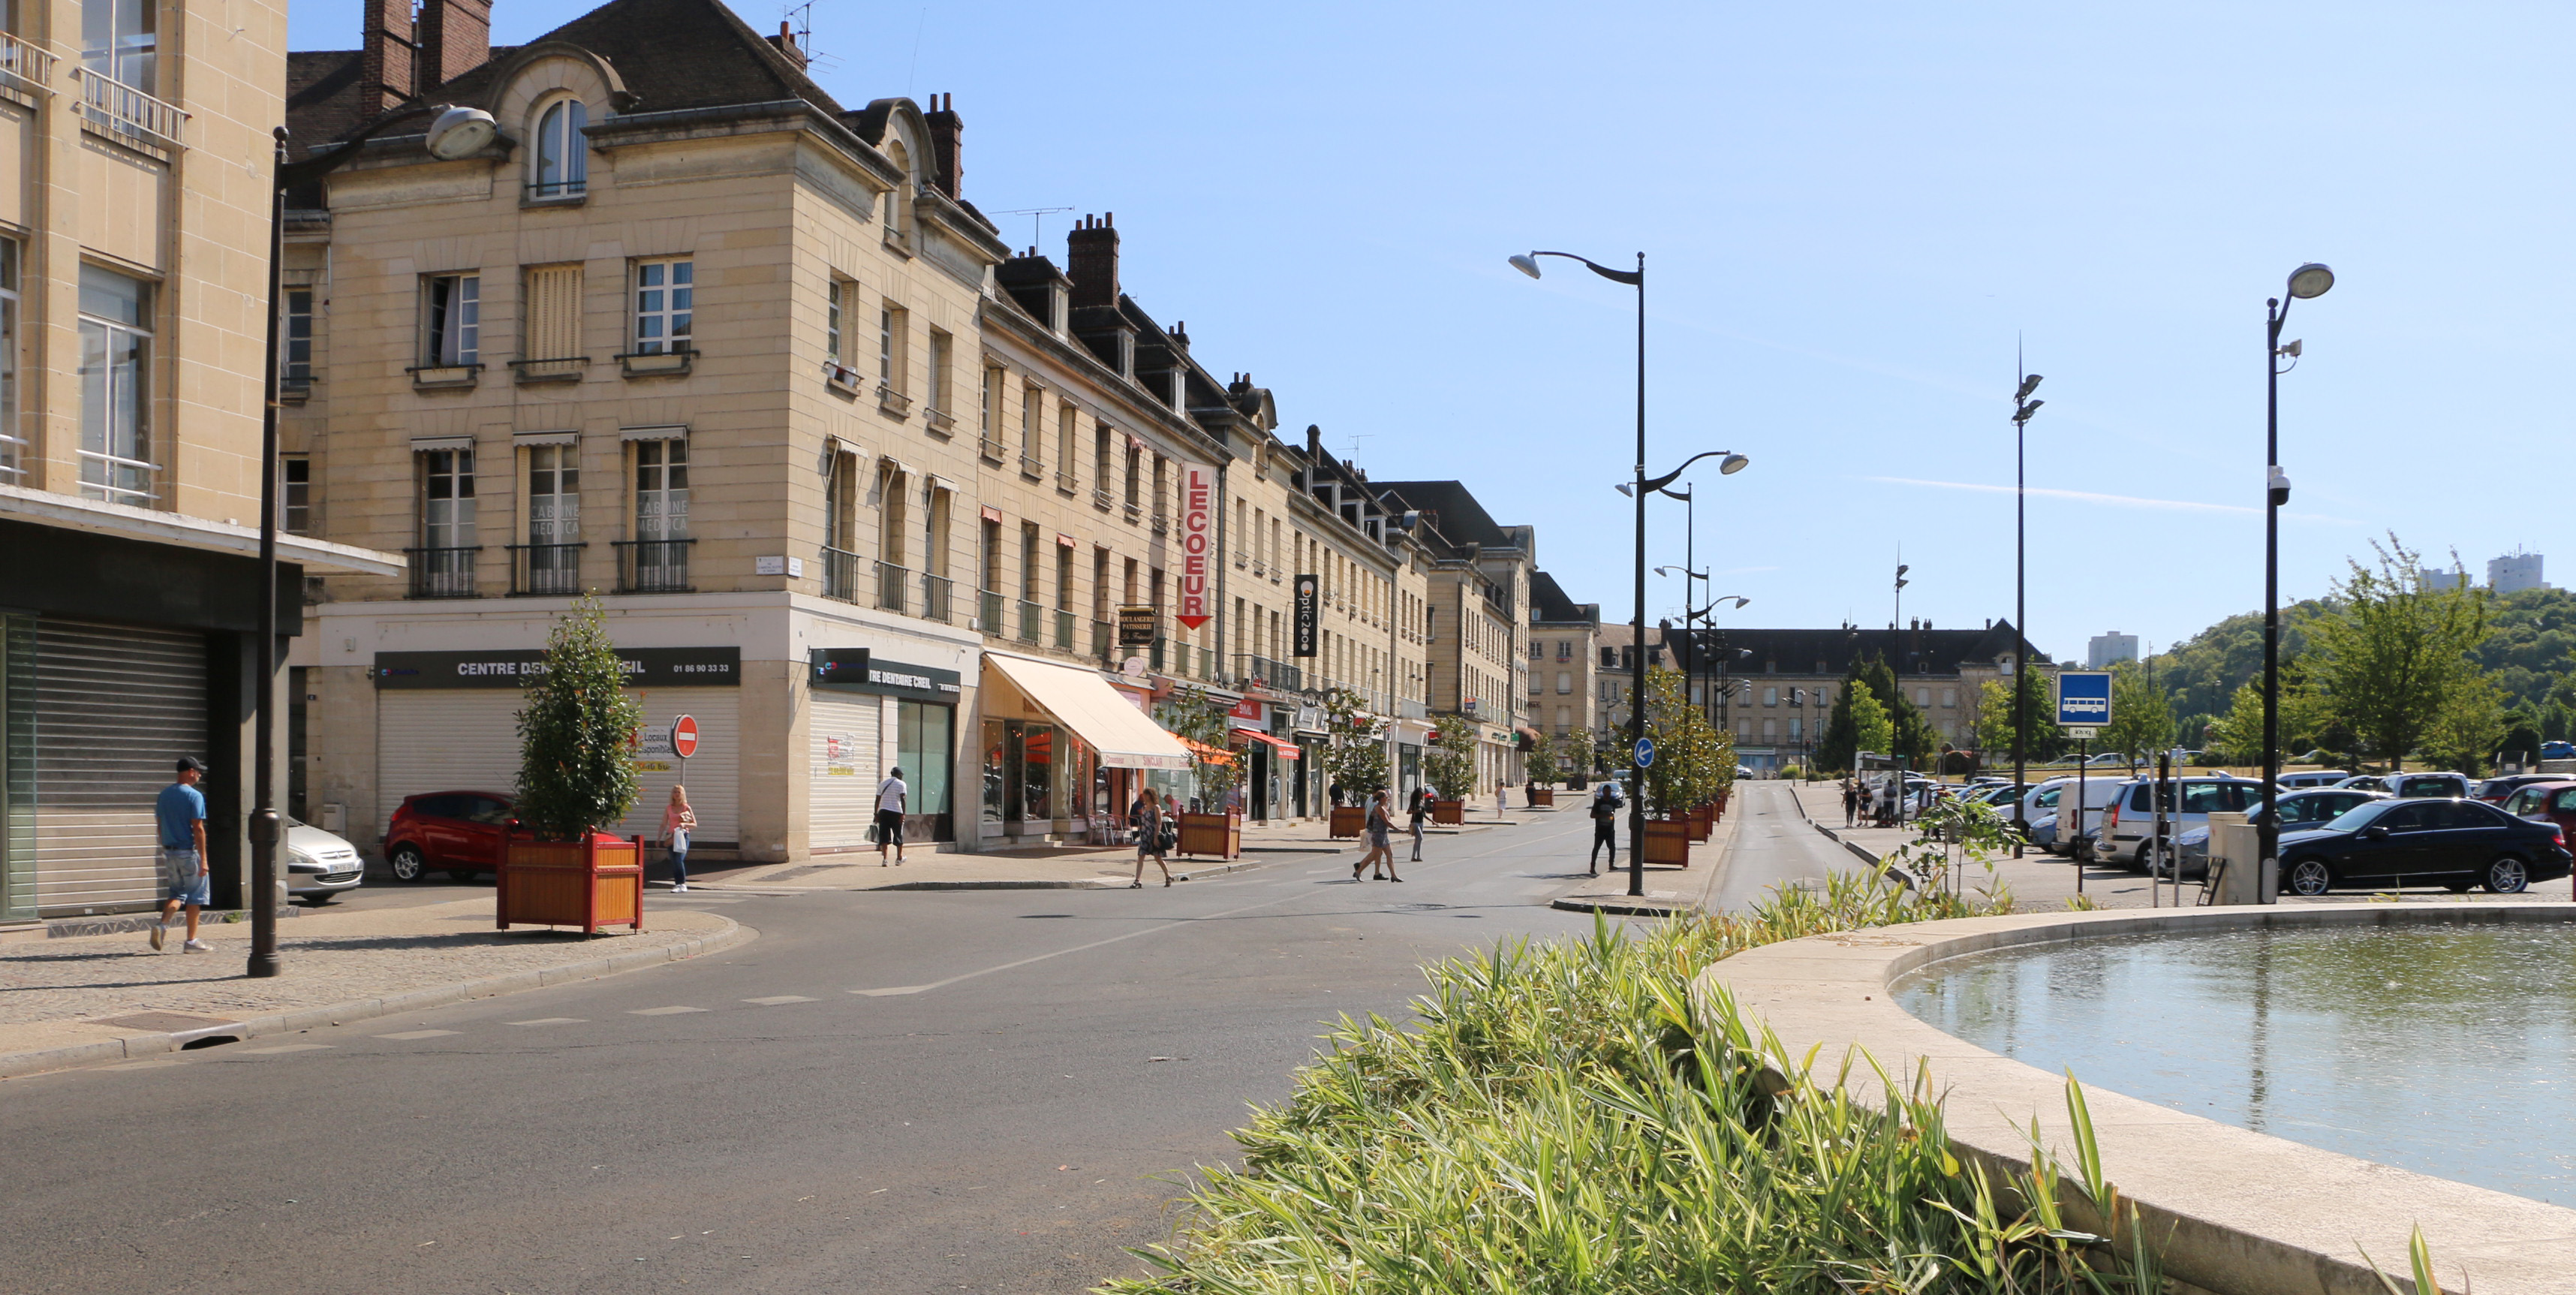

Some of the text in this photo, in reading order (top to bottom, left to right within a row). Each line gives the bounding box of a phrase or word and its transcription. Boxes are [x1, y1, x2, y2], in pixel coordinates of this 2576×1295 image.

[1184, 470, 1208, 616] LECOEUR
[457, 662, 516, 676] CENTRE
[673, 664, 729, 673] 01 86 90 33 33
[882, 670, 913, 688] DENTAIRE
[913, 675, 931, 690] CREIL
[644, 733, 668, 742] Locaux
[1143, 756, 1163, 767] SINCLAIR
